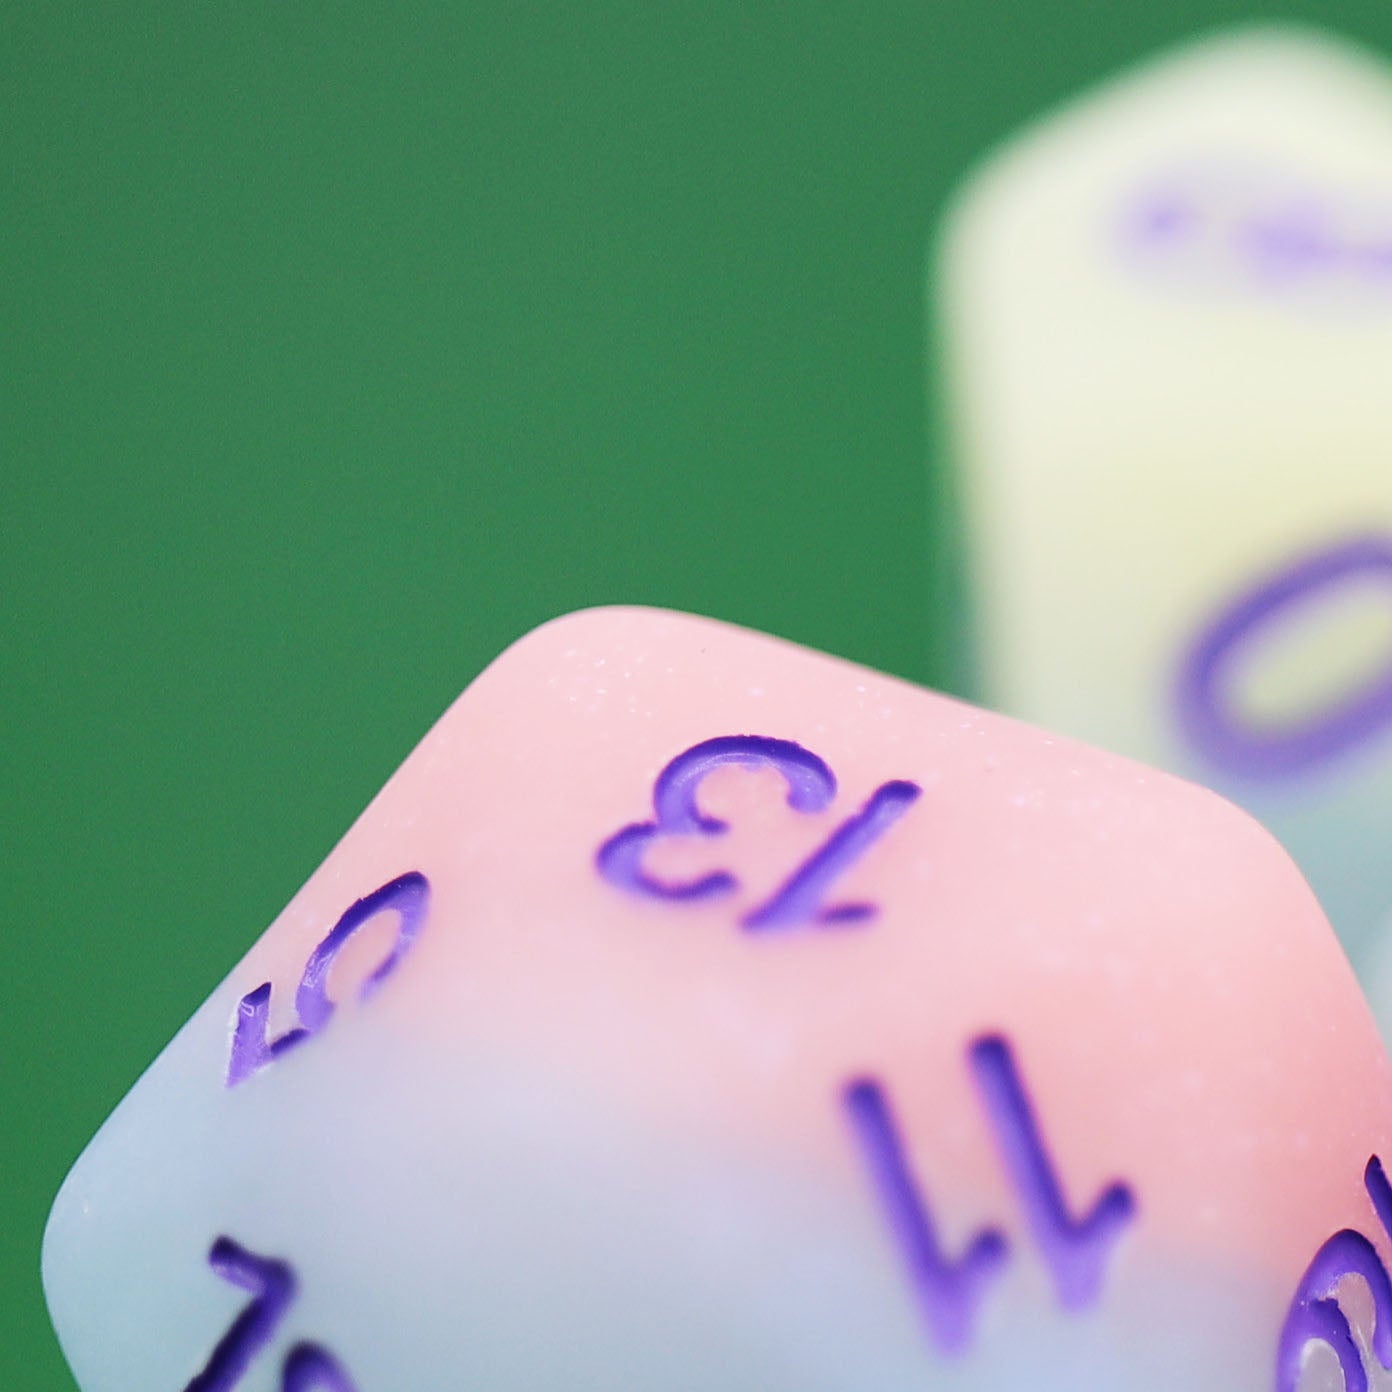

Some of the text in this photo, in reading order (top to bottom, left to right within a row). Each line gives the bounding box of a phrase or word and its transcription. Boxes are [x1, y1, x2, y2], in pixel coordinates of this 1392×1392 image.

[594, 733, 923, 937] 13
[225, 870, 431, 1088] 5
[838, 1032, 1137, 1360] 11
